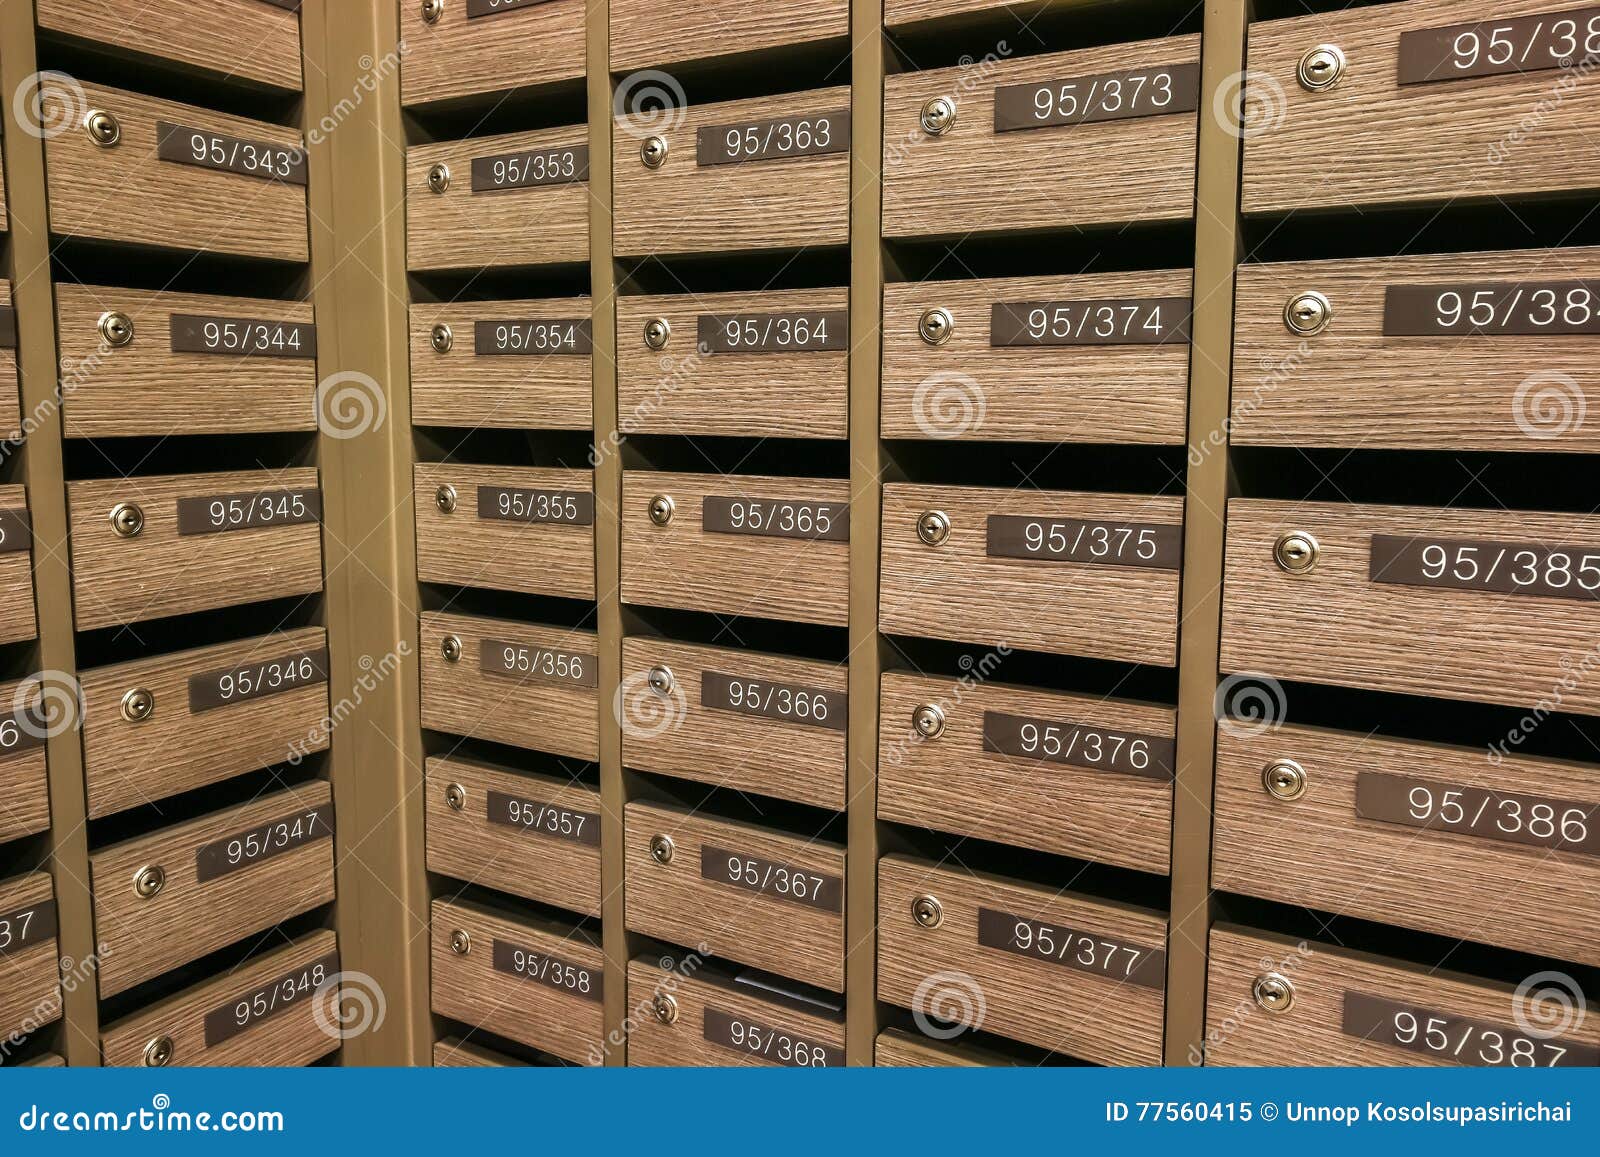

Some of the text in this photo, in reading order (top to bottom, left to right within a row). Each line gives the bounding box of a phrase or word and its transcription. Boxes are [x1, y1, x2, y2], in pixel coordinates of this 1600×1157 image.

[1453, 15, 1600, 69] 95/38
[1034, 73, 1172, 120] 95/373
[191, 134, 291, 177] 95/343
[726, 118, 830, 157] 95/363
[493, 152, 575, 184] 95/353
[1028, 305, 1163, 339] 95/374
[1436, 288, 1600, 327] 95/38
[204, 322, 301, 350] 95/344
[496, 325, 576, 349] 95/354
[726, 317, 828, 346] 95/364
[210, 494, 305, 526] 95/345
[498, 492, 577, 520] 95/355
[730, 502, 831, 534] 95/365
[1025, 520, 1158, 560] 95/375
[1422, 540, 1600, 590] 95/385
[219, 656, 313, 699] 95/346
[503, 647, 583, 679] 95/356
[729, 681, 828, 721] 95/366
[1020, 723, 1149, 769] 95/376
[509, 800, 586, 837] 95/357
[1408, 787, 1588, 843] 95/386
[227, 812, 318, 864] 95/347
[728, 857, 824, 901] 95/367
[1015, 922, 1141, 975] 95/377
[514, 950, 590, 993] 95/358
[235, 964, 325, 1025] 95/348
[730, 1021, 827, 1067] 95/368
[1394, 1011, 1567, 1067] 95/387
